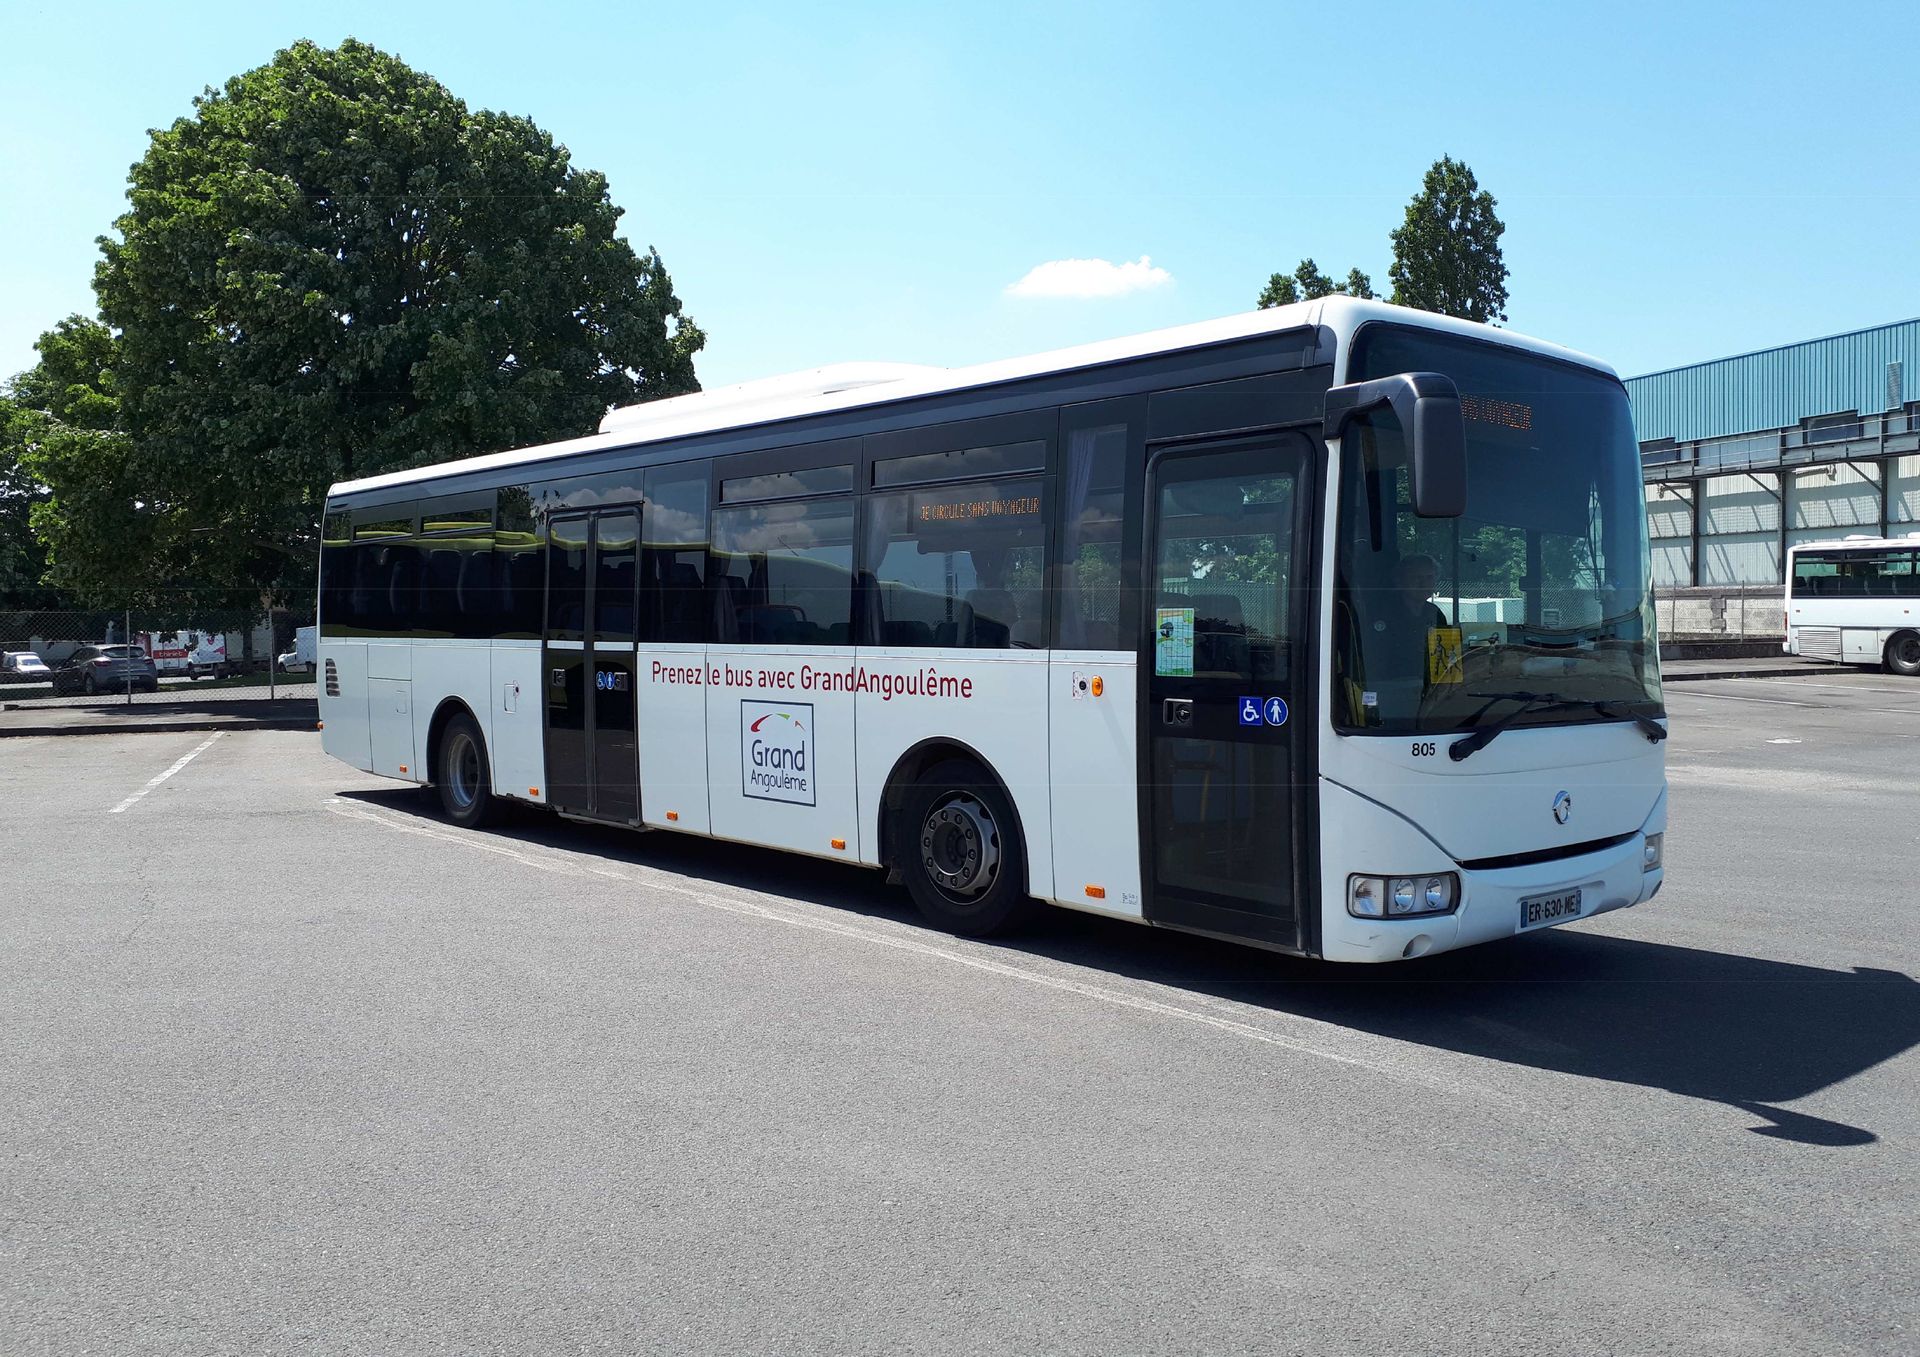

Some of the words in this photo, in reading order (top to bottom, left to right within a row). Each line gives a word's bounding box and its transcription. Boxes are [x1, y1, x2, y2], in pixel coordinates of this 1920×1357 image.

[921, 505, 929, 520] JE
[932, 503, 965, 519] CIRCULE
[967, 501, 989, 517] SANS
[991, 497, 1039, 515] VOYAGEUR
[652, 661, 702, 685] Prenez
[706, 662, 721, 685] le
[725, 663, 753, 688] bus
[758, 669, 795, 690] avec
[800, 664, 973, 700] GrandAngoulême
[751, 739, 805, 771] Grand
[1411, 742, 1436, 757] 805
[750, 769, 807, 792] Angoulême
